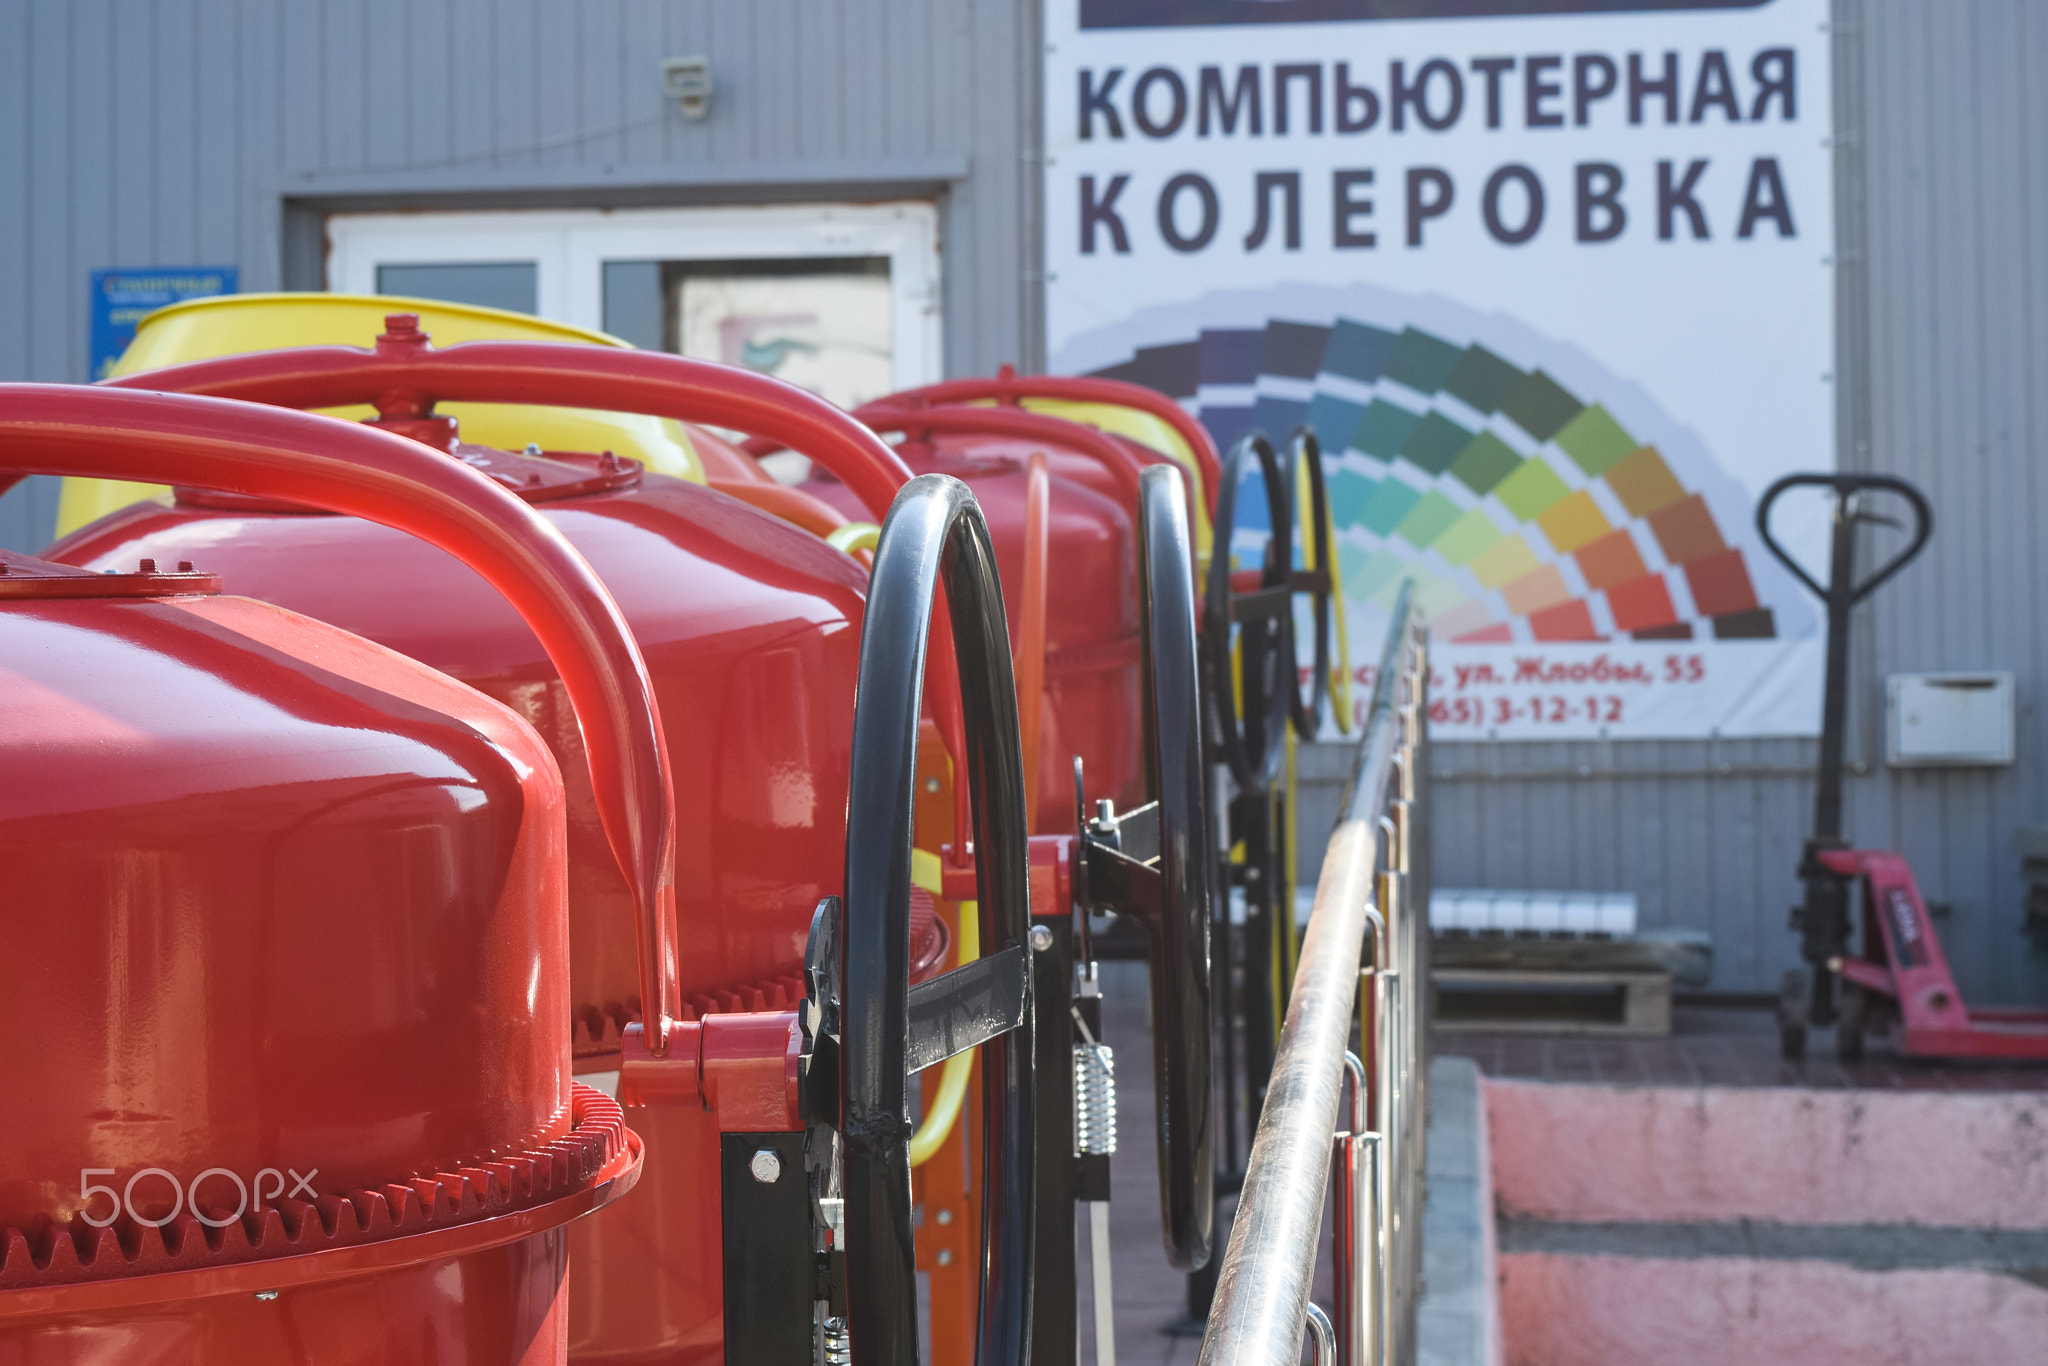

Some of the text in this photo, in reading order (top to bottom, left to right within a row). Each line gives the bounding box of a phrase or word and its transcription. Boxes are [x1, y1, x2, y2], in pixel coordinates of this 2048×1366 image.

[1078, 48, 1798, 140] КОМПЬЮТЕРНАЯ
[1079, 157, 1798, 254] КОЛЕРОВКА
[1454, 664, 1504, 690] ул.
[1513, 655, 1653, 685] Жлобы,
[1664, 655, 1705, 682] 55
[1493, 695, 1623, 726] 3-12-12
